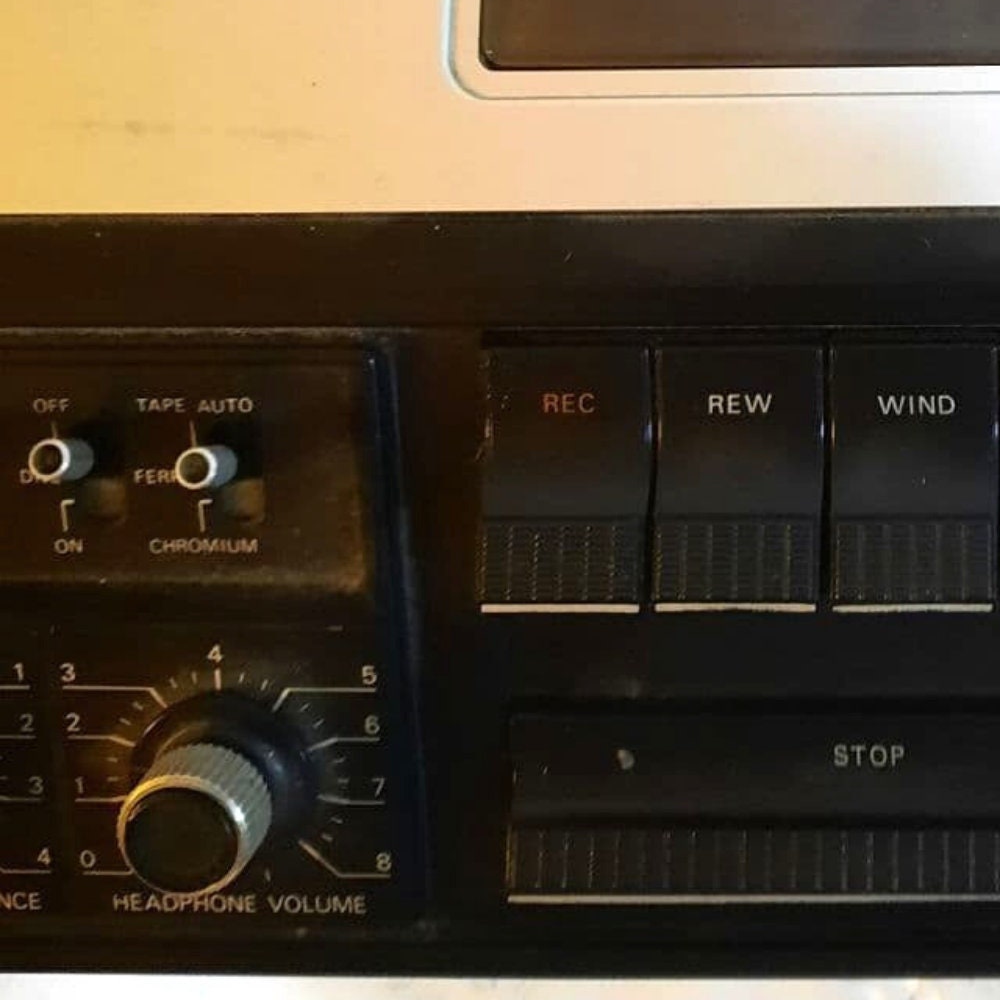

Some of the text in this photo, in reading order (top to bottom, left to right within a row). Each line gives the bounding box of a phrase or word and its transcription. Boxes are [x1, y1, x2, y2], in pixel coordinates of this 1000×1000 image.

[32, 398, 71, 414] OFF
[136, 398, 254, 413] TAPE AUTO
[543, 393, 596, 414] REC
[707, 393, 772, 415] REW
[878, 394, 956, 415] WIND
[54, 538, 84, 554] ON
[149, 538, 259, 554] CHROMIUM
[207, 643, 224, 663] 4
[12, 662, 26, 681] 1
[60, 663, 76, 682] 3
[361, 665, 378, 684] 5
[20, 713, 35, 732] 2
[65, 712, 81, 732] 2
[364, 715, 380, 734] 6
[833, 744, 905, 768] STOP
[28, 776, 44, 795] 3
[75, 776, 86, 794] 1
[371, 777, 386, 796] 7
[37, 847, 51, 866] 4
[80, 850, 96, 868] 0
[376, 852, 392, 871] 8
[113, 893, 366, 914] HEADPHONE VOLUME
